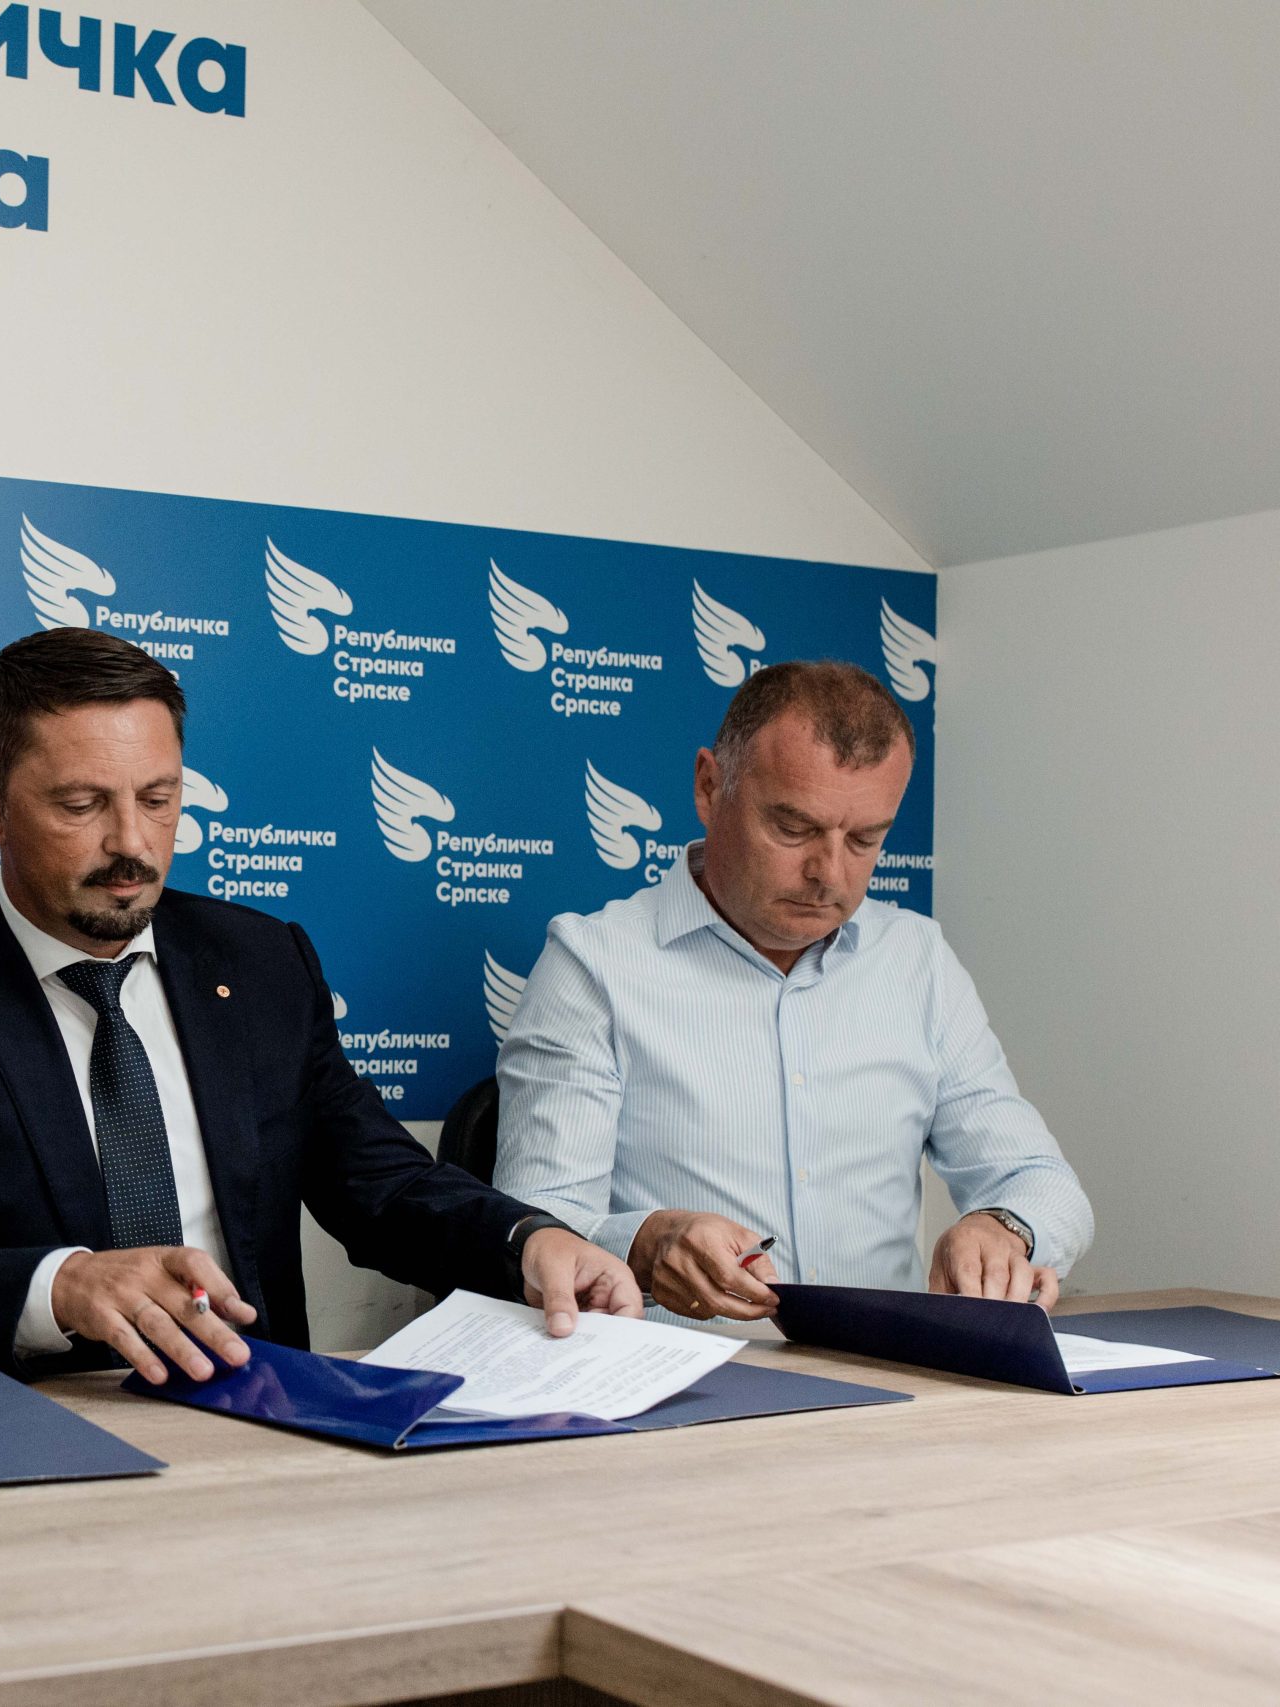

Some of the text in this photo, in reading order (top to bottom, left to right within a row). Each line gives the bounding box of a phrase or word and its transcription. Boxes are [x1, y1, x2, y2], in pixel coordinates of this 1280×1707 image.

[96, 605, 229, 636] Републичка
[127, 640, 194, 660] анка
[334, 624, 456, 654] Републичка
[334, 650, 424, 678] Странка
[552, 642, 662, 670] Републичка
[333, 676, 411, 703] Српске
[551, 667, 633, 693] Странка
[551, 692, 621, 717] Српске
[209, 821, 336, 849] Републичка
[437, 831, 553, 857] Републичка
[208, 848, 303, 875] Странка
[436, 856, 522, 882] Странка
[877, 850, 934, 870] бличка
[208, 874, 289, 901] Српске
[436, 882, 510, 907] Српске
[869, 876, 910, 892] анка
[338, 1028, 450, 1054] епубличка
[348, 1059, 418, 1078] ранка
